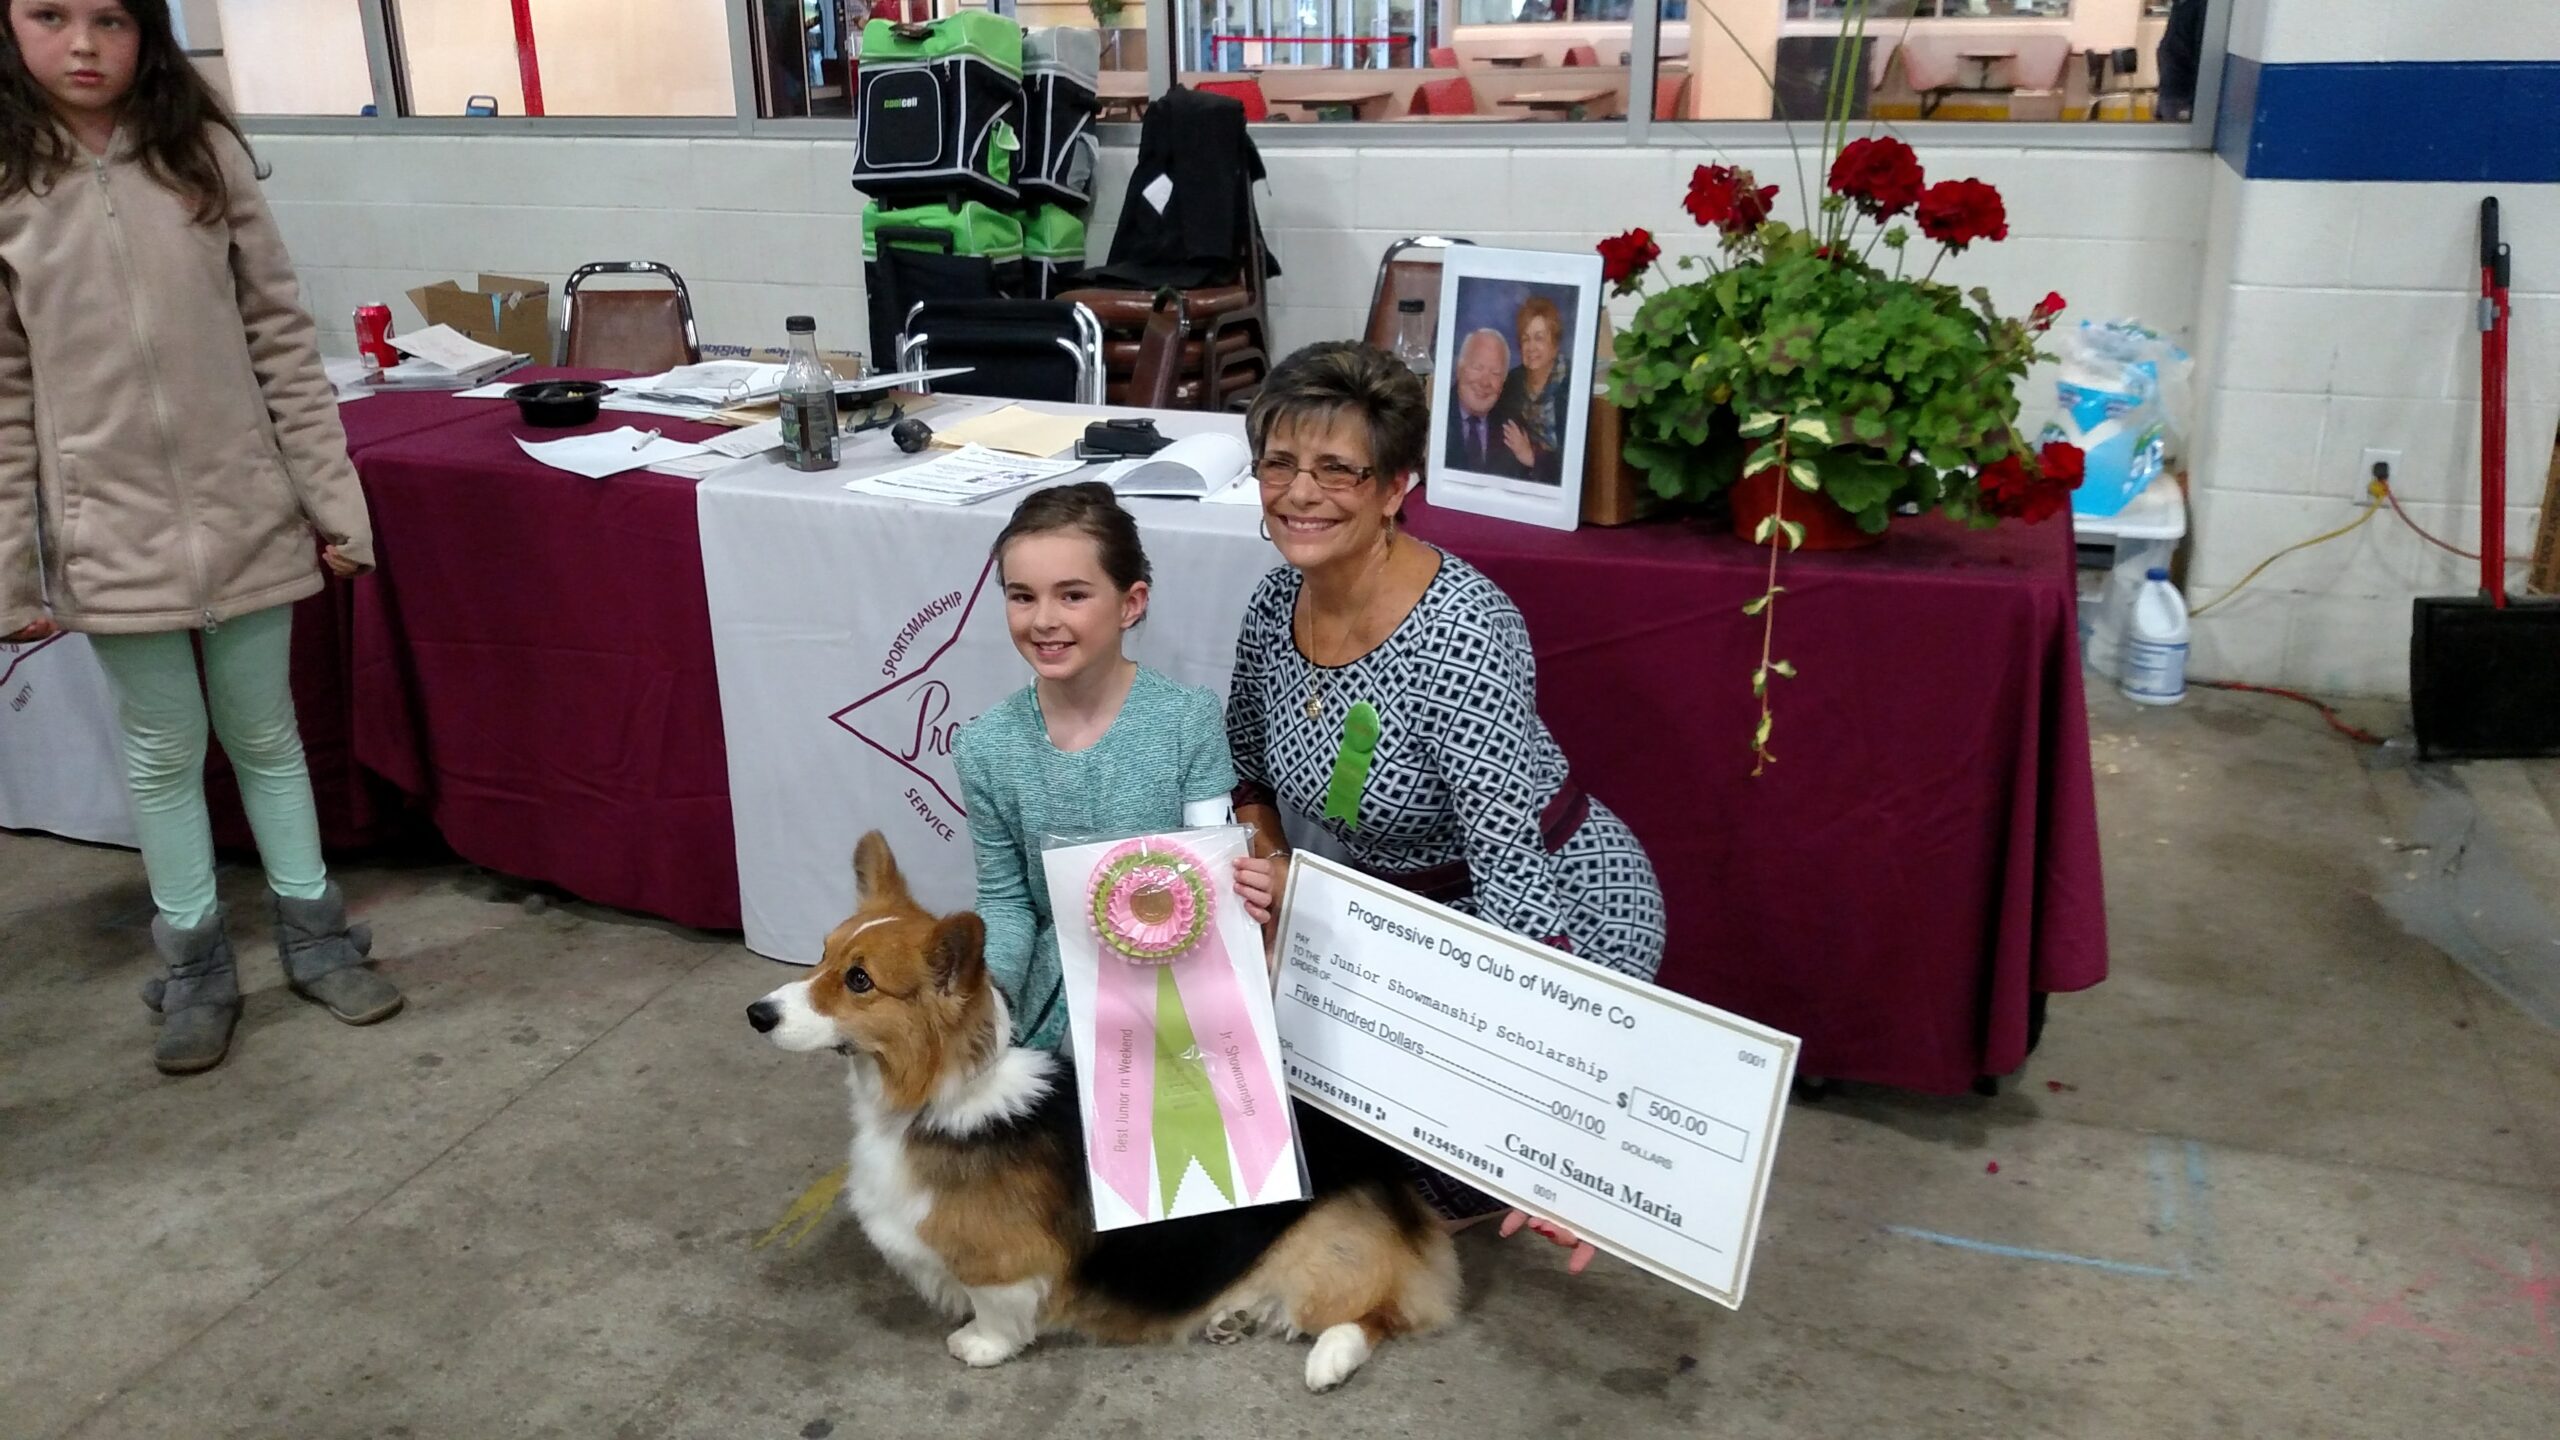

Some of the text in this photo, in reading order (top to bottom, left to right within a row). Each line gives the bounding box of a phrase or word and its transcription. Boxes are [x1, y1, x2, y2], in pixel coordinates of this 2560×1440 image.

[882, 591, 962, 678] SPORTSMANSHIP
[9, 681, 34, 712] UNITY
[904, 787, 956, 843] SERVICE
[1293, 944, 1321, 965] TO THE
[1295, 931, 1311, 946] PAY
[1290, 956, 1332, 982] ORDER OF
[1347, 900, 1636, 1030] Progressive Dog Club of Wayne Co
[1294, 983, 1321, 1007] Five
[1322, 997, 1377, 1033] Hundred
[1329, 953, 1609, 1083] Junior Showmanship Scholarship
[1219, 1031, 1256, 1118] Jr. Showmanship
[1737, 1050, 1767, 1069] 0001
[1113, 1028, 1135, 1153] Best Junior in Weekend
[1616, 1092, 1708, 1137] $ 500.00
[1620, 1140, 1674, 1170] DOLLARS
[1504, 1133, 1684, 1227] Carol Santa Maria
[1533, 1183, 1558, 1203] 0001
